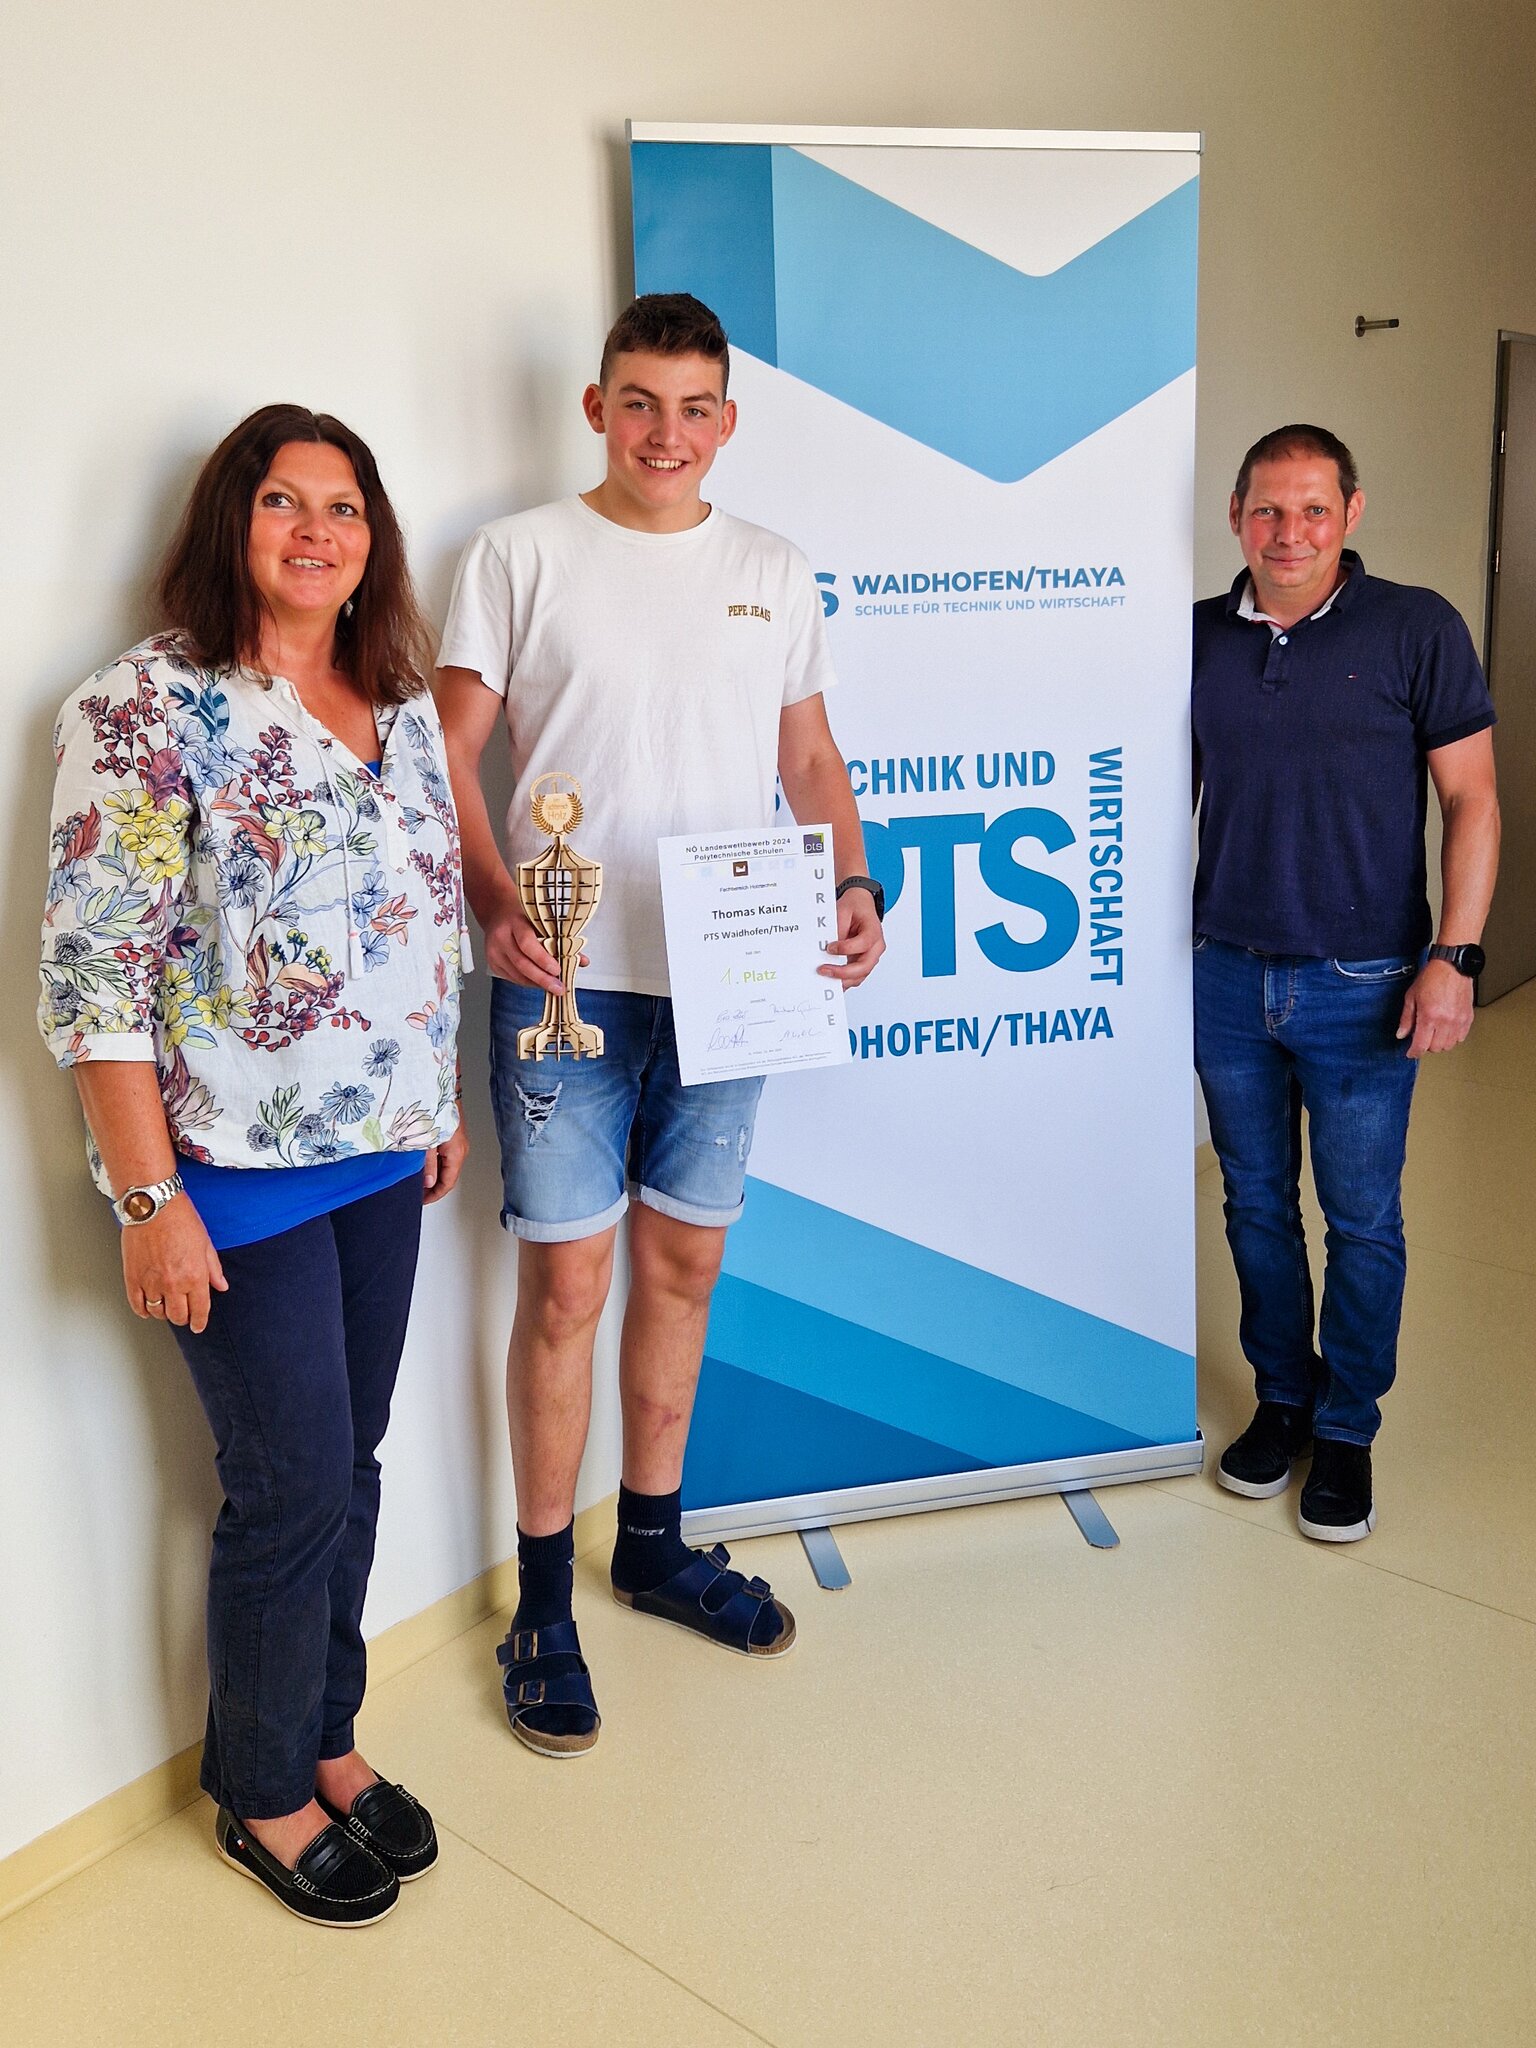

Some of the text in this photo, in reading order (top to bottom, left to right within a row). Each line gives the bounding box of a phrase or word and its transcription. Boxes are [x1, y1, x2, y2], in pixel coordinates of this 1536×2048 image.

[852, 566, 1126, 595] WAIDHOFEN/THAYA
[728, 604, 748, 617] PEPE
[855, 596, 1126, 617] SCHULE FÜR TECHNIK UND WIRTSCHAFT
[849, 750, 1056, 797] CHNIK UND
[700, 839, 770, 852] Landeswettbewerb
[773, 837, 791, 845] 2024
[694, 847, 784, 861] Polytechnische Schulen
[1089, 746, 1124, 986] WIRTSCHAFT
[712, 904, 788, 920] Thomas Kainz
[703, 923, 799, 941] PTS Waidhofen/Thaya
[743, 969, 777, 983] Platz
